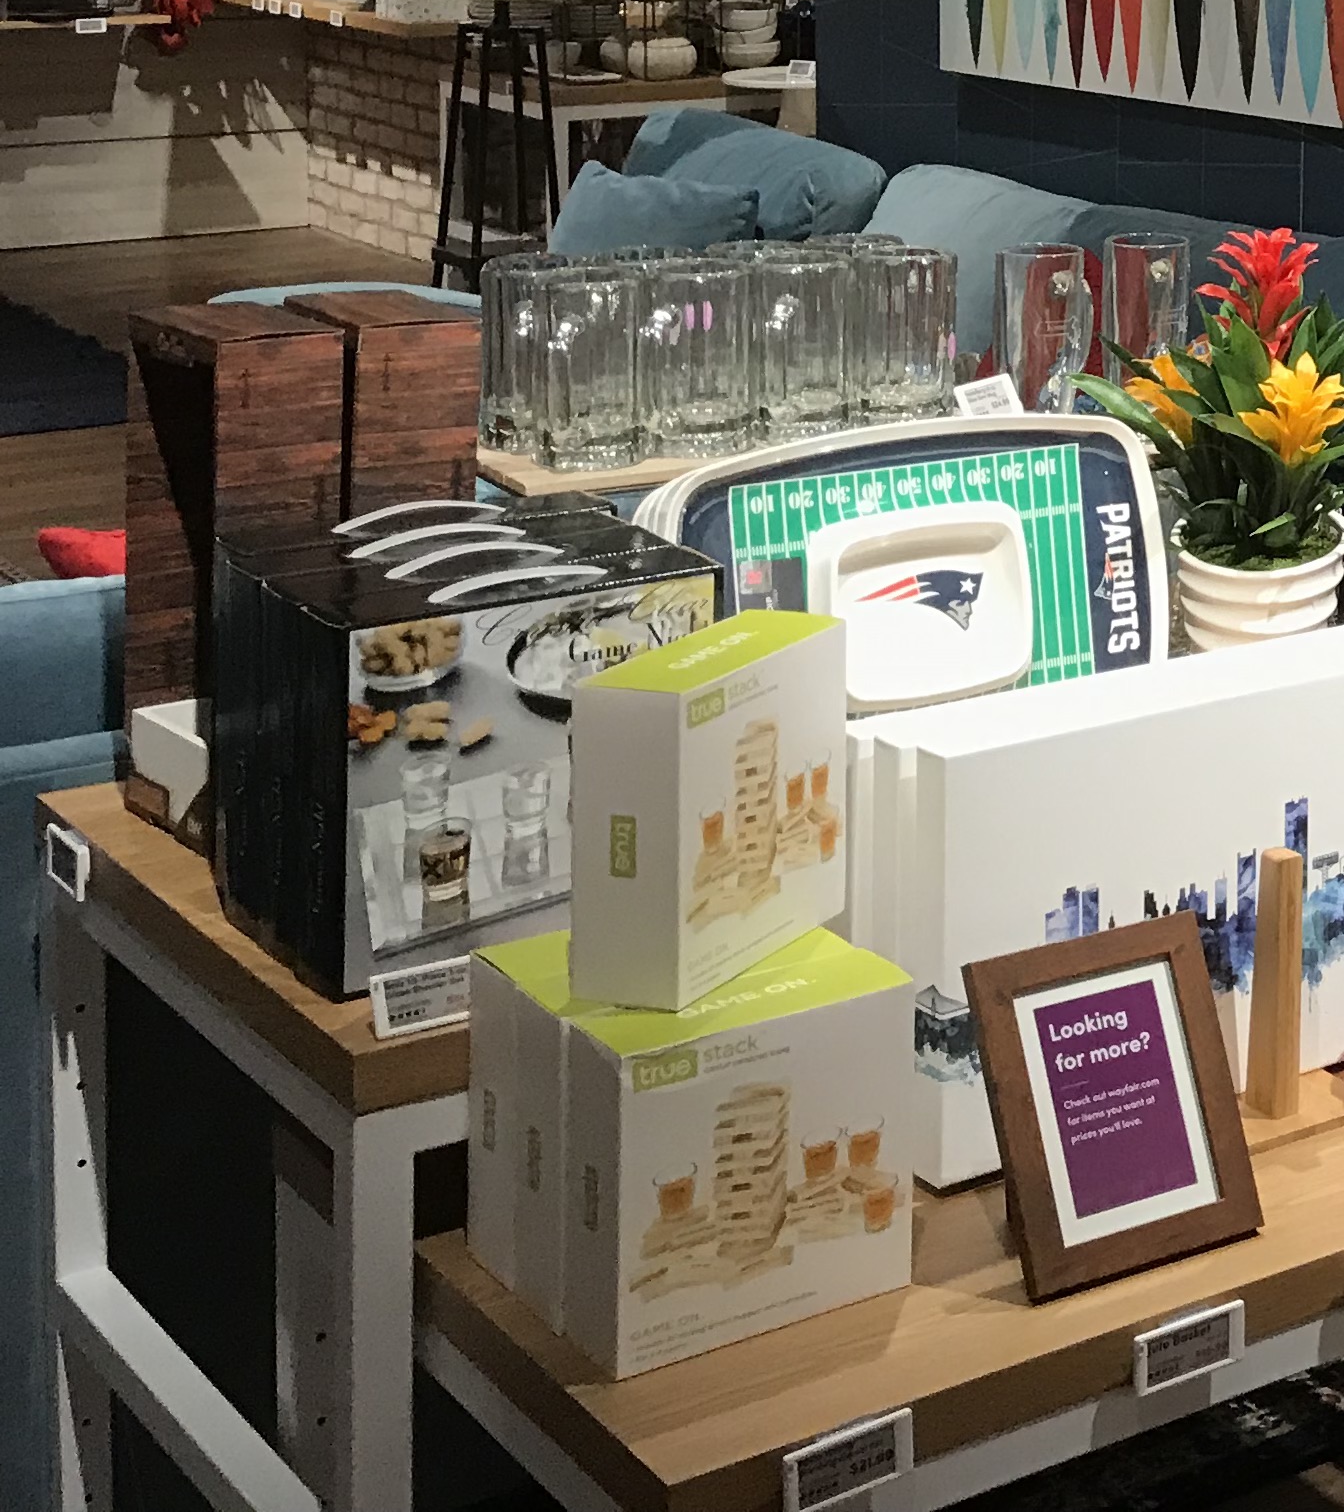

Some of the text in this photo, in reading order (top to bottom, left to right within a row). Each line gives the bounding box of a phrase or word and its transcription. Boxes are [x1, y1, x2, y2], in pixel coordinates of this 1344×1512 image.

[750, 457, 1057, 515] 10 20 30 40 50 40 30 20 10
[1096, 502, 1141, 655] PATRIOTS
[568, 636, 638, 663] Game
[690, 694, 723, 723] true
[728, 675, 760, 701] stack
[613, 822, 632, 871] true
[1049, 1010, 1128, 1042] Looking
[638, 1058, 692, 1088] true
[703, 1035, 758, 1063] stack
[1055, 1031, 1151, 1073] for more?
[1063, 1078, 1160, 1110] Check out wayfair.com
[1067, 1095, 1156, 1126] for items you want at
[1070, 1116, 1143, 1145] prices you'll love.
